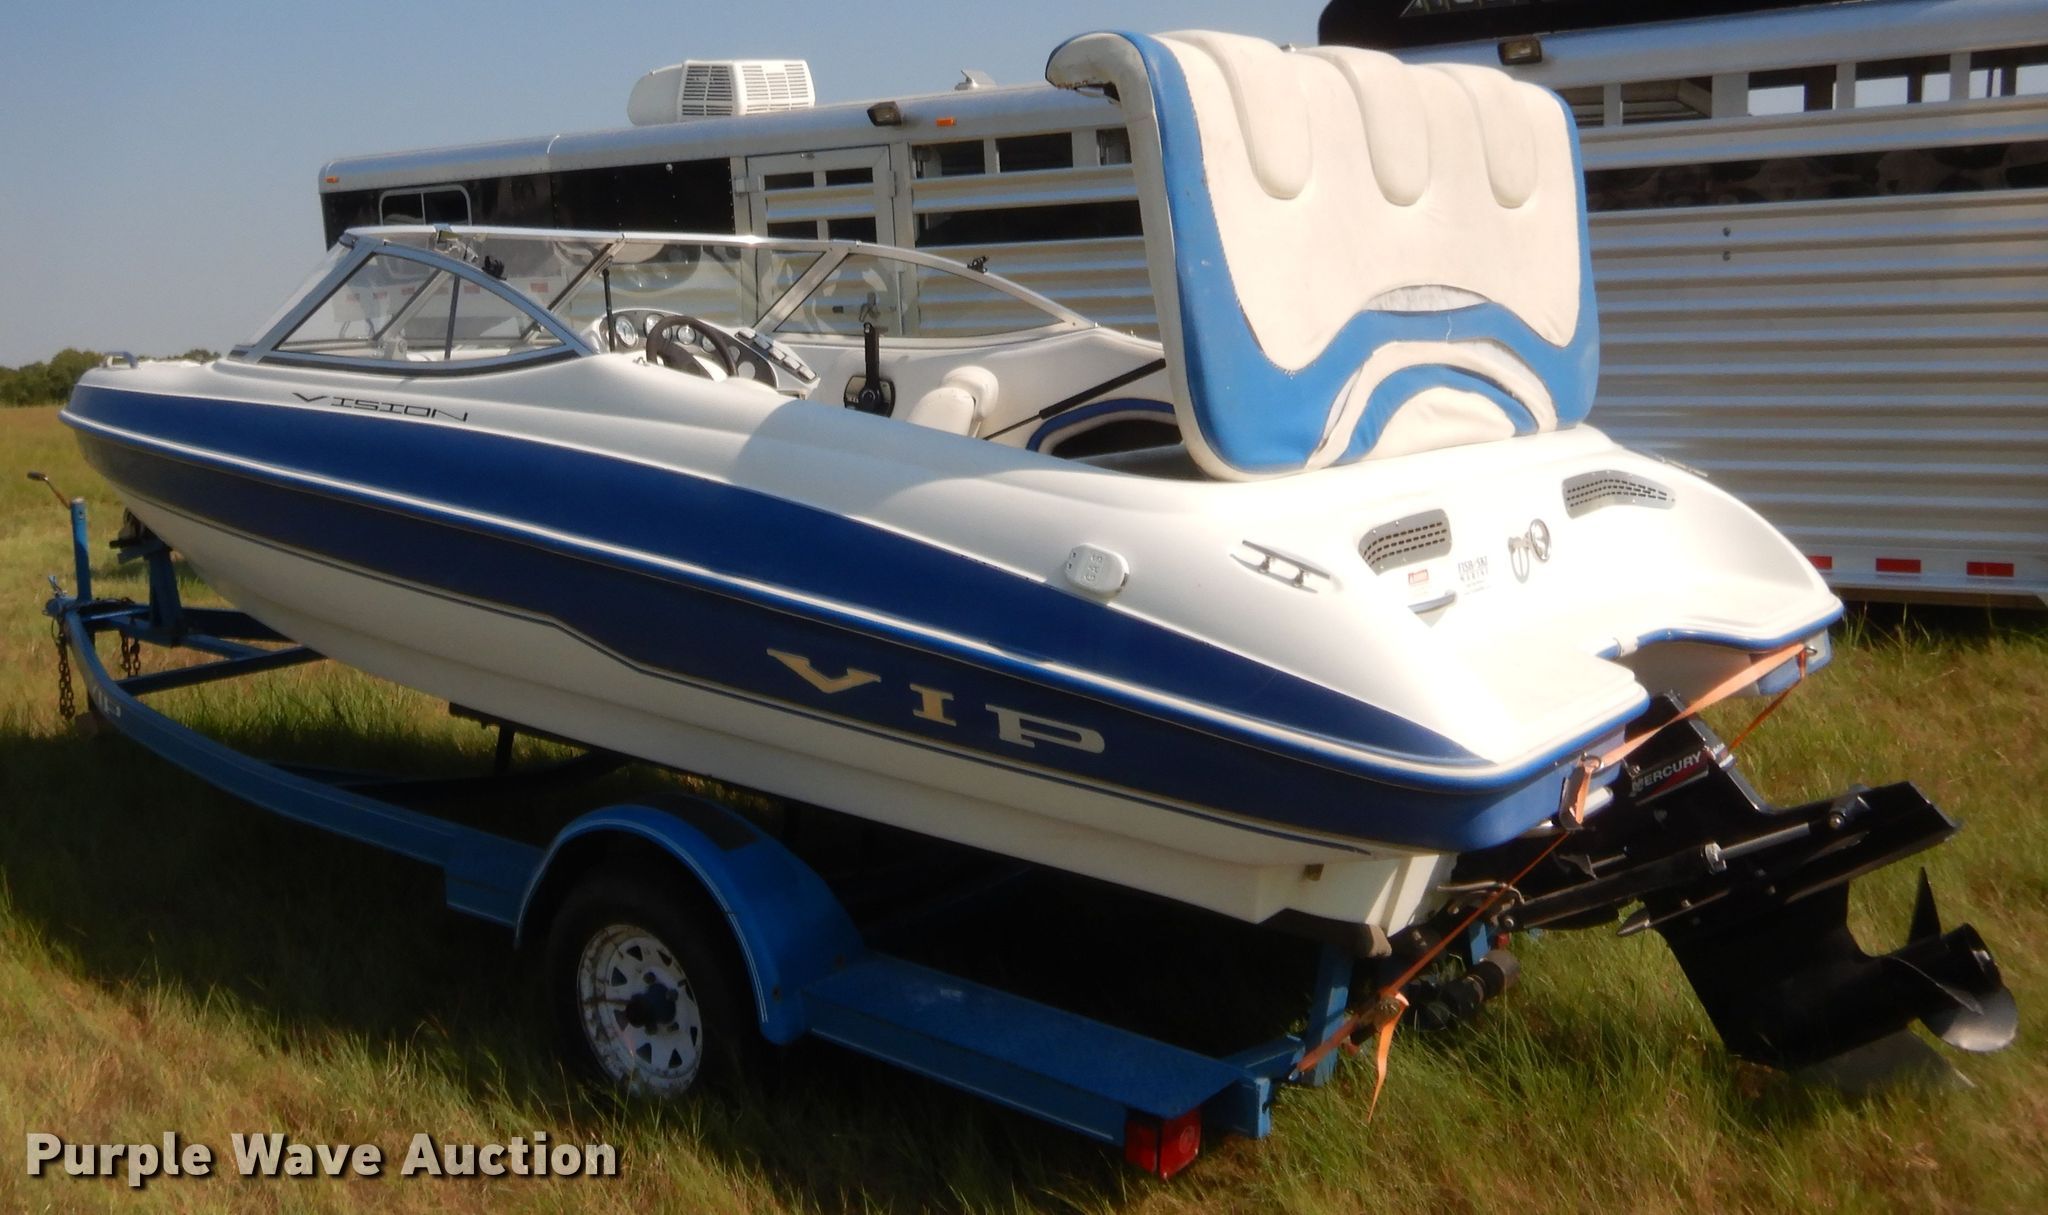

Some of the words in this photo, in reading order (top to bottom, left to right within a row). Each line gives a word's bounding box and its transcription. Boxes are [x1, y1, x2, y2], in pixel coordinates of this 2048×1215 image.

[292, 392, 468, 422] VISION
[766, 648, 1106, 754] VIP
[1631, 751, 1701, 793] MERCURY
